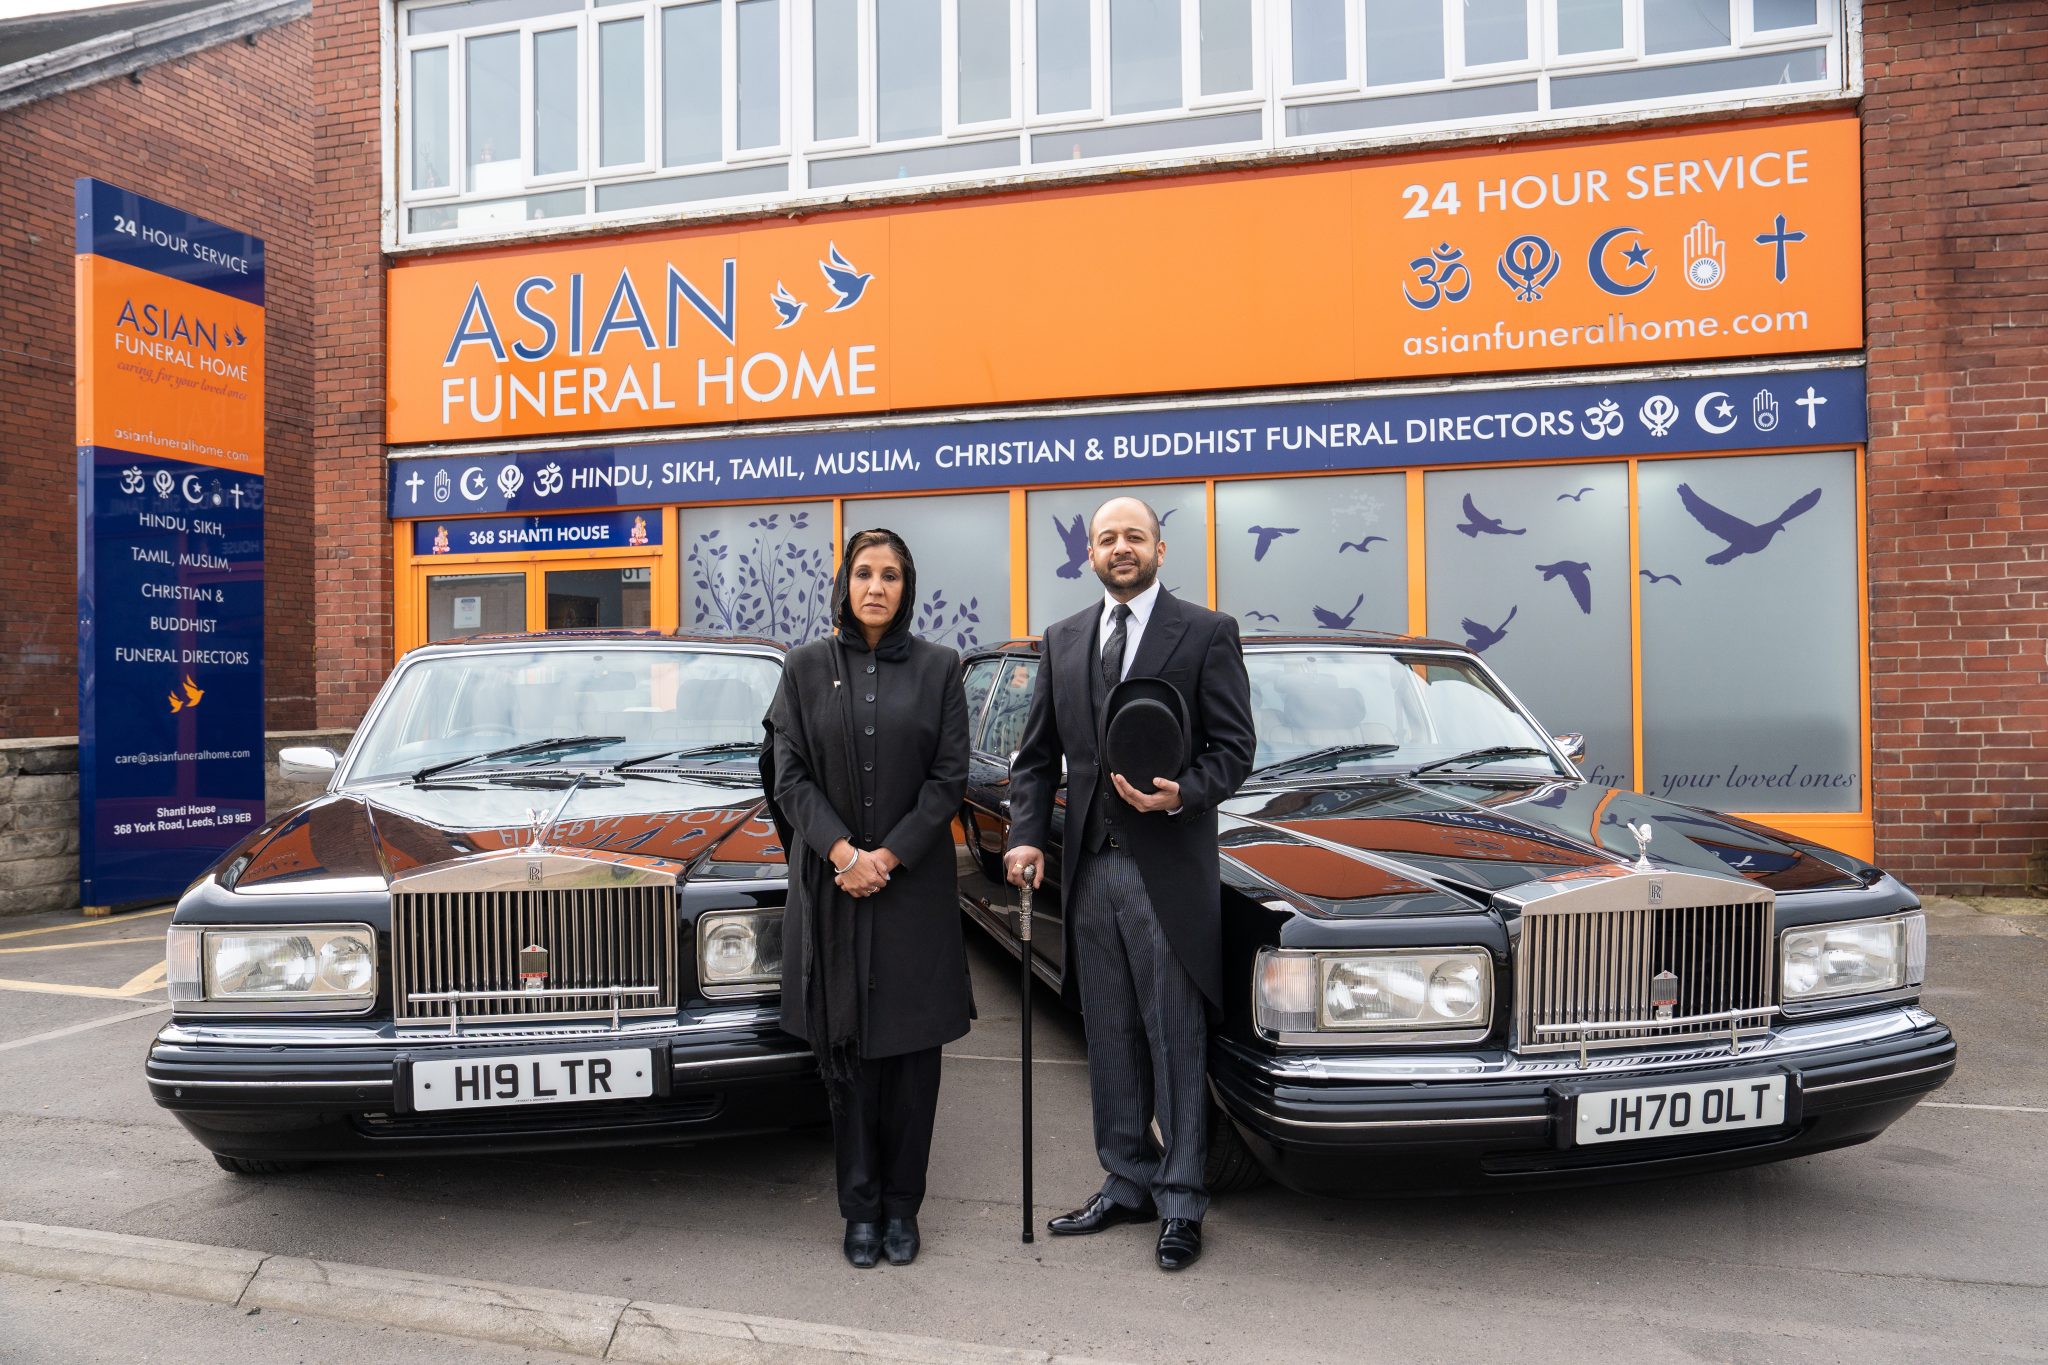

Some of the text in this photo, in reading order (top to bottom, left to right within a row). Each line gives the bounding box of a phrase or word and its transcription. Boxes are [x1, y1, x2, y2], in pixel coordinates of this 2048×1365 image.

[1401, 149, 1809, 220] 24 HOUR SERVICE
[113, 215, 248, 275] 24 HOUR SERVICE
[116, 300, 217, 352] ASIAN
[442, 257, 738, 368] ASIAN
[1403, 309, 1809, 357] asianfuneralhome.com
[115, 333, 248, 382] FUNERAL HOME
[117, 361, 248, 401] caring for your loved ones
[442, 343, 876, 425] FUNERAL HOME
[114, 428, 249, 462] asianfuneralhome.com
[571, 410, 1575, 490] HINDU, SIKH, TAMIL, MUSLIM, CHRISTIAN & BUDDHIST FUNERAL DIRECTORS
[139, 512, 226, 538] HINDU, SIKH,
[469, 525, 609, 545] 368 SHANTI HOUSE
[131, 546, 232, 573] TAMIL, MUSLIM,
[141, 583, 224, 603] CHRISTIAN &
[150, 616, 216, 633] BUDDHIST
[115, 647, 249, 665] FUNERAL DIRECTORS
[115, 748, 250, 765] care@asianfuneralhome.com
[1586, 764, 1856, 797] for your loved ones
[113, 812, 252, 835] 368 York Road, Leeds, LS9 9EB
[156, 804, 216, 818] Shanti House
[455, 1058, 612, 1101] H19 LTR
[1595, 1083, 1771, 1135] JH70 OLT
